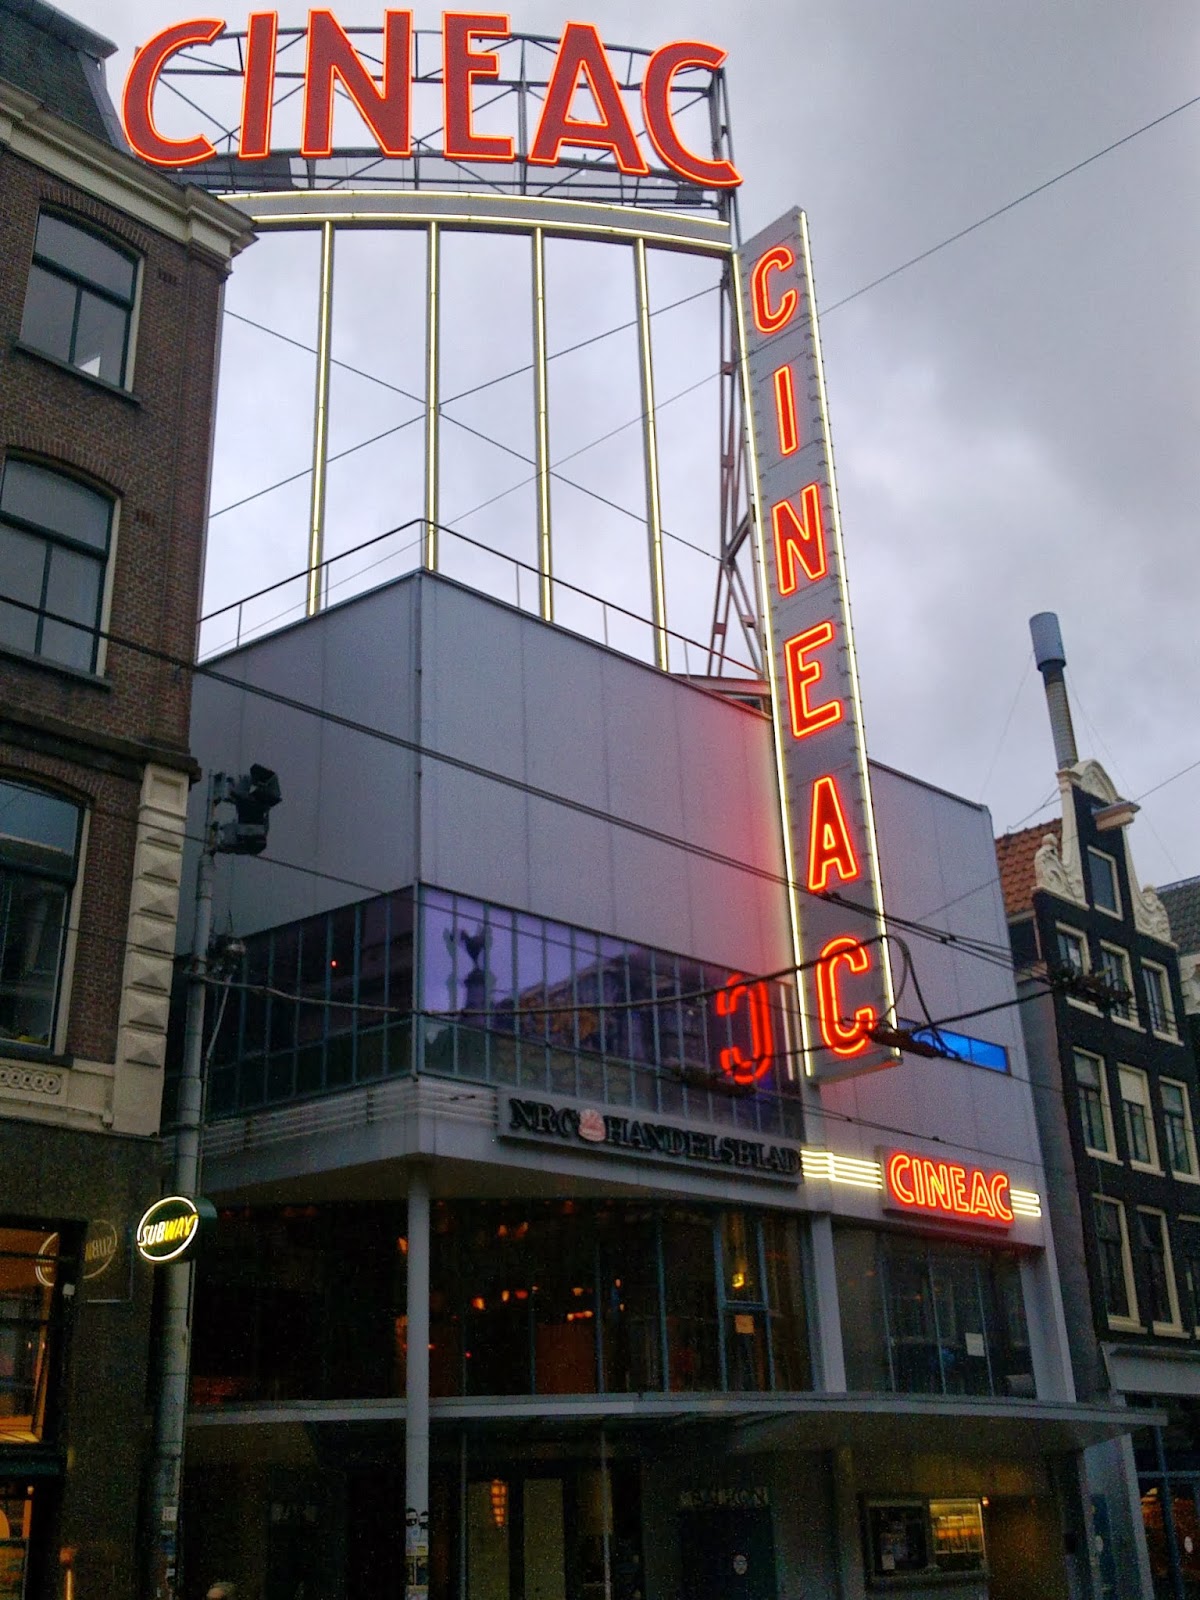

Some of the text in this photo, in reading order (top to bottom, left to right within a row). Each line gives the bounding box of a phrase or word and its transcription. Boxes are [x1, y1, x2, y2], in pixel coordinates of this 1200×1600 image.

[121, 8, 743, 187] CINEAC
[750, 245, 875, 1056] CINEAC
[507, 1098, 800, 1174] NRC HANDELSBLAD
[889, 1153, 1015, 1221] CINEAC
[137, 1213, 199, 1247] SUBWAY
